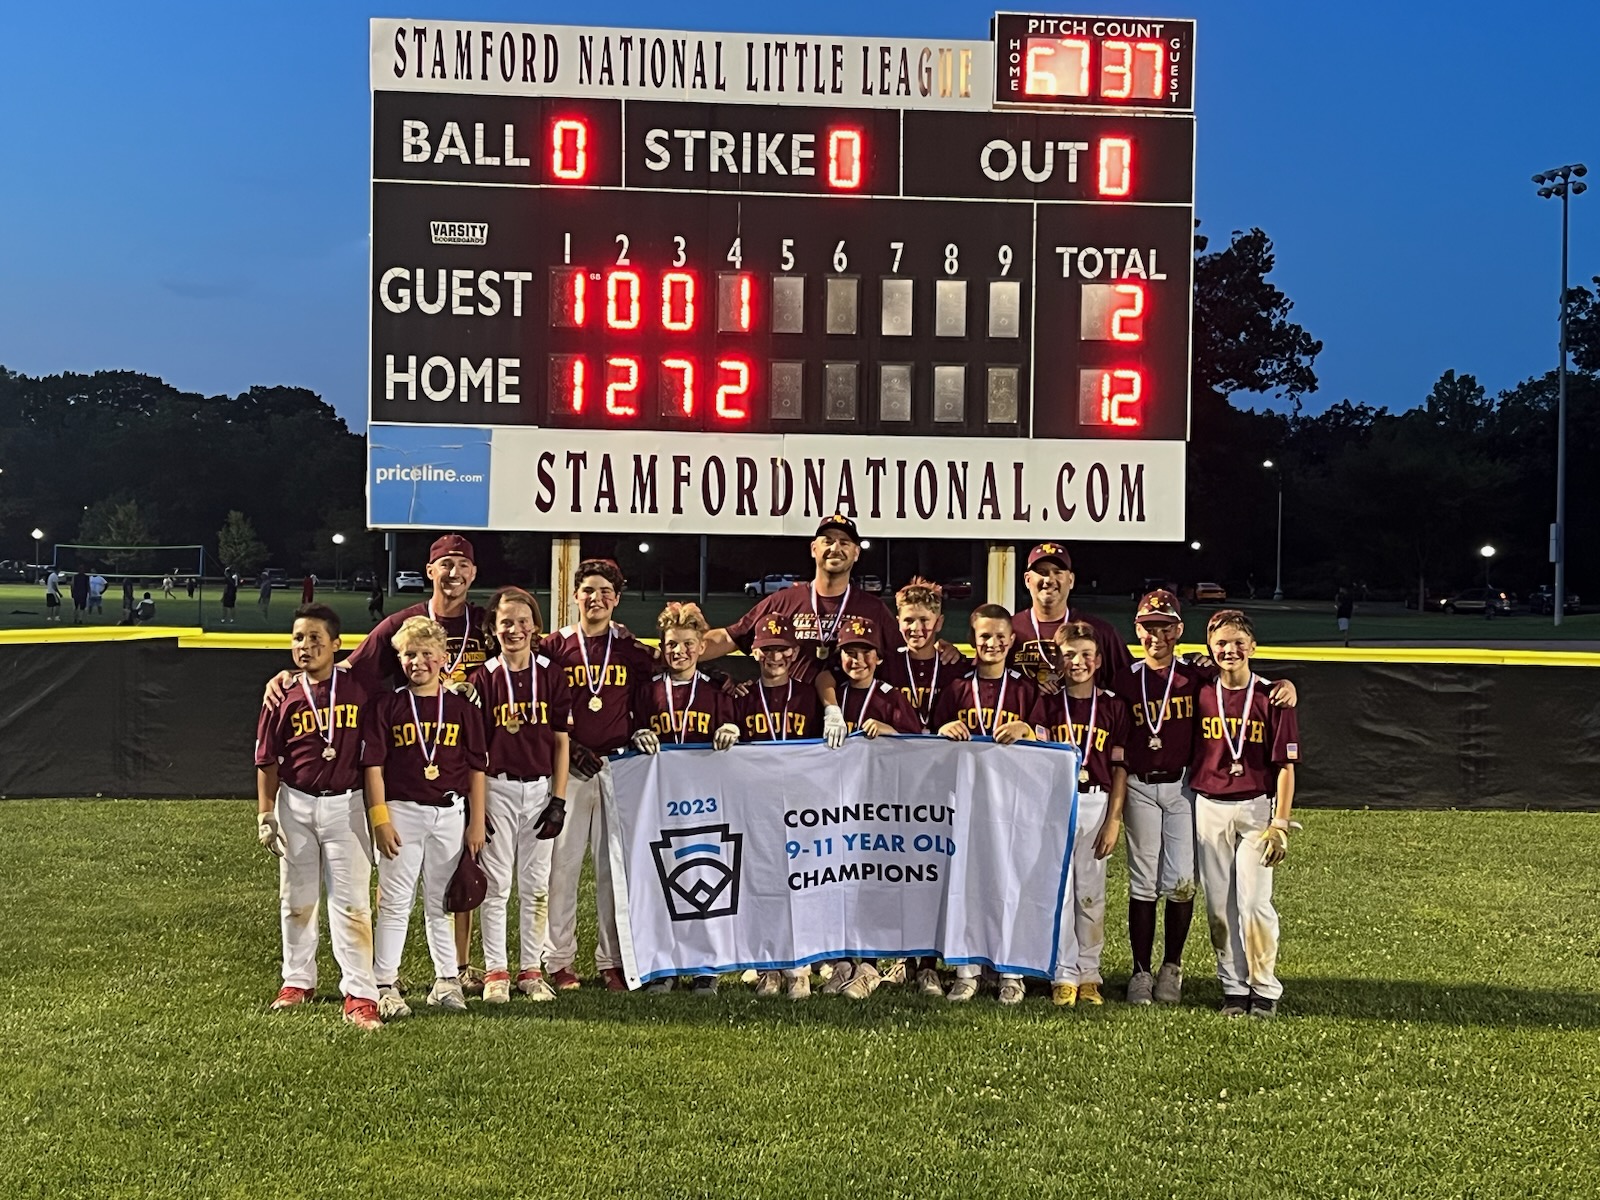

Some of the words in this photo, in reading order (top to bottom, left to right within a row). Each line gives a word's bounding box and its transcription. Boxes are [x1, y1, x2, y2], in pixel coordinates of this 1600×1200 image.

[1028, 19, 1087, 36] PITCH
[1093, 22, 1165, 39] COUNT
[393, 25, 559, 84] STAMFORD
[578, 34, 726, 92] NATIONAL
[746, 41, 844, 95] LITTLE
[861, 45, 973, 99] LEAGUE
[1009, 38, 1021, 92] HOME
[1102, 39, 1164, 99] 37
[1169, 38, 1181, 103] GUEST
[402, 119, 531, 167] BALL
[552, 119, 587, 180] 0
[645, 128, 816, 176] STRIKE
[828, 129, 861, 189] 0
[980, 139, 1089, 183] OUT
[1098, 137, 1132, 196] 0
[432, 223, 486, 237] VARSITY
[564, 233, 571, 264] 1
[615, 234, 630, 266] 2
[672, 236, 687, 268] 3
[726, 237, 743, 270] 4
[781, 239, 795, 271] 5
[833, 241, 848, 273] 6
[890, 243, 904, 273] 7
[944, 244, 959, 276] 8
[997, 245, 1013, 277] 9
[1055, 246, 1168, 280] TOTAL
[379, 267, 532, 317] GUEST
[573, 272, 585, 327] 1
[606, 270, 640, 330] 0
[661, 272, 695, 331] 0
[739, 277, 751, 330] 1
[1111, 283, 1144, 342] 2
[385, 354, 520, 404] HOME
[572, 359, 584, 412] 1
[605, 358, 639, 416] 2
[660, 358, 694, 415] 7
[715, 360, 750, 419] 2
[1102, 368, 1142, 426] 12
[376, 464, 483, 484] priceline.com
[535, 450, 1146, 523] STAMFORDNATIONAL.COM
[563, 664, 628, 688] SOUTH
[290, 703, 359, 737] SOUTH
[649, 710, 712, 737] SOUTH
[745, 711, 807, 738] SOUTH
[666, 797, 718, 817] 2023
[783, 803, 956, 828] CONNECTICUT
[784, 837, 833, 860] 9-11
[842, 832, 906, 853] YEAR
[913, 833, 957, 858] OLD
[787, 862, 939, 891] CHAMPIONS
